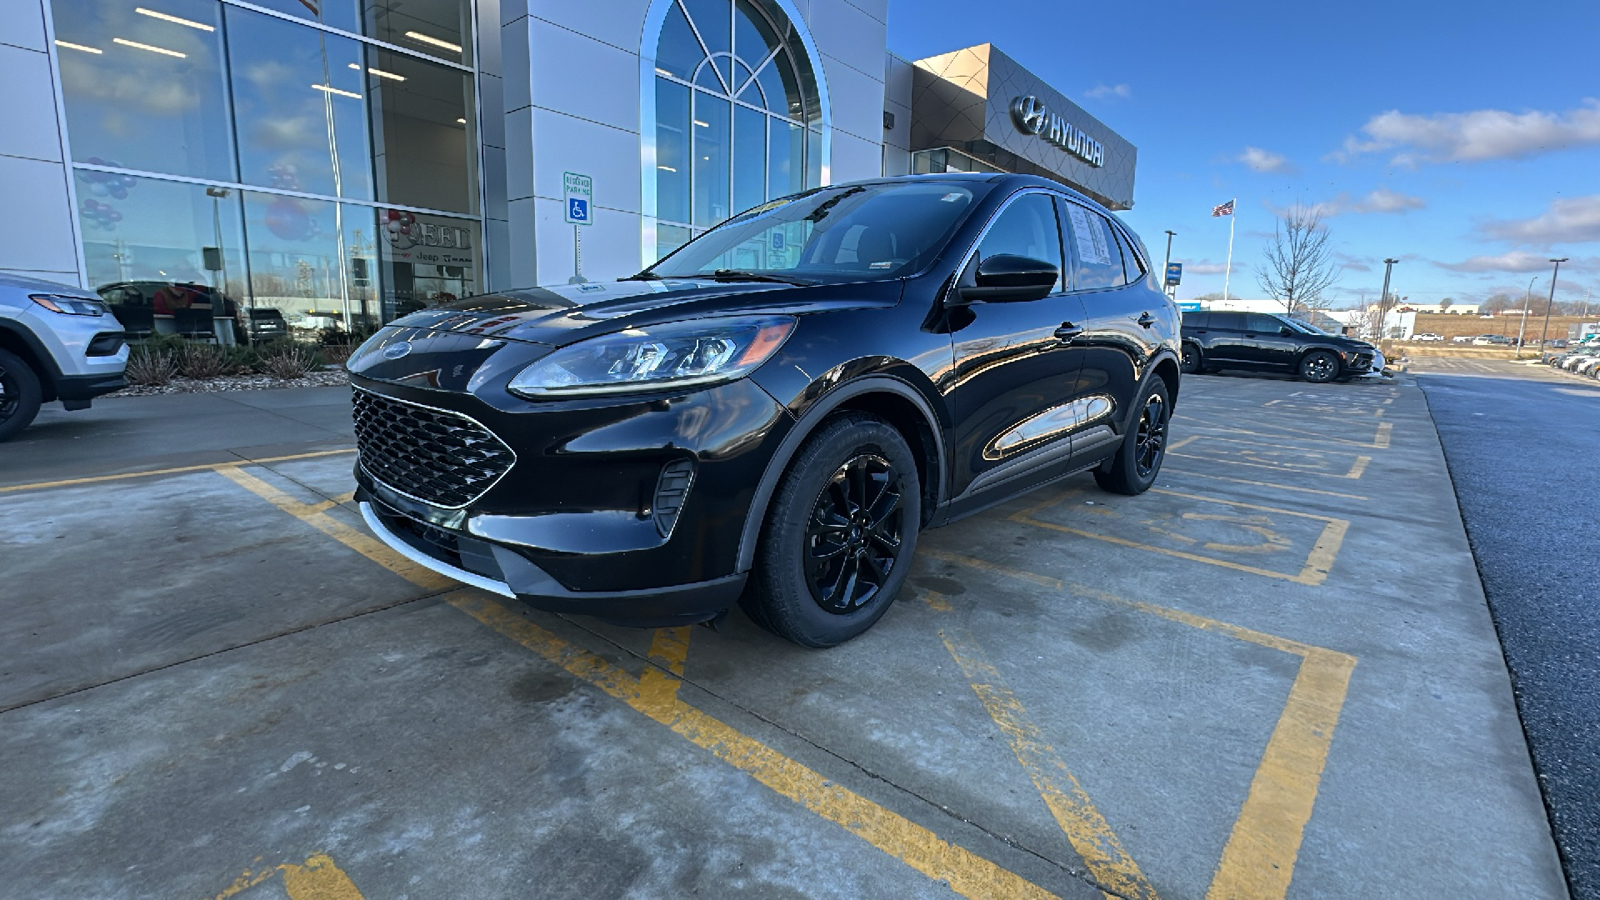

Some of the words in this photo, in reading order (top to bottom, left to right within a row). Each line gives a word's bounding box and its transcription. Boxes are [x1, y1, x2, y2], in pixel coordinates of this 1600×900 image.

[1050, 113, 1104, 167] HYUNDAI
[566, 185, 590, 195] PARKING
[416, 252, 439, 262] Jeep
